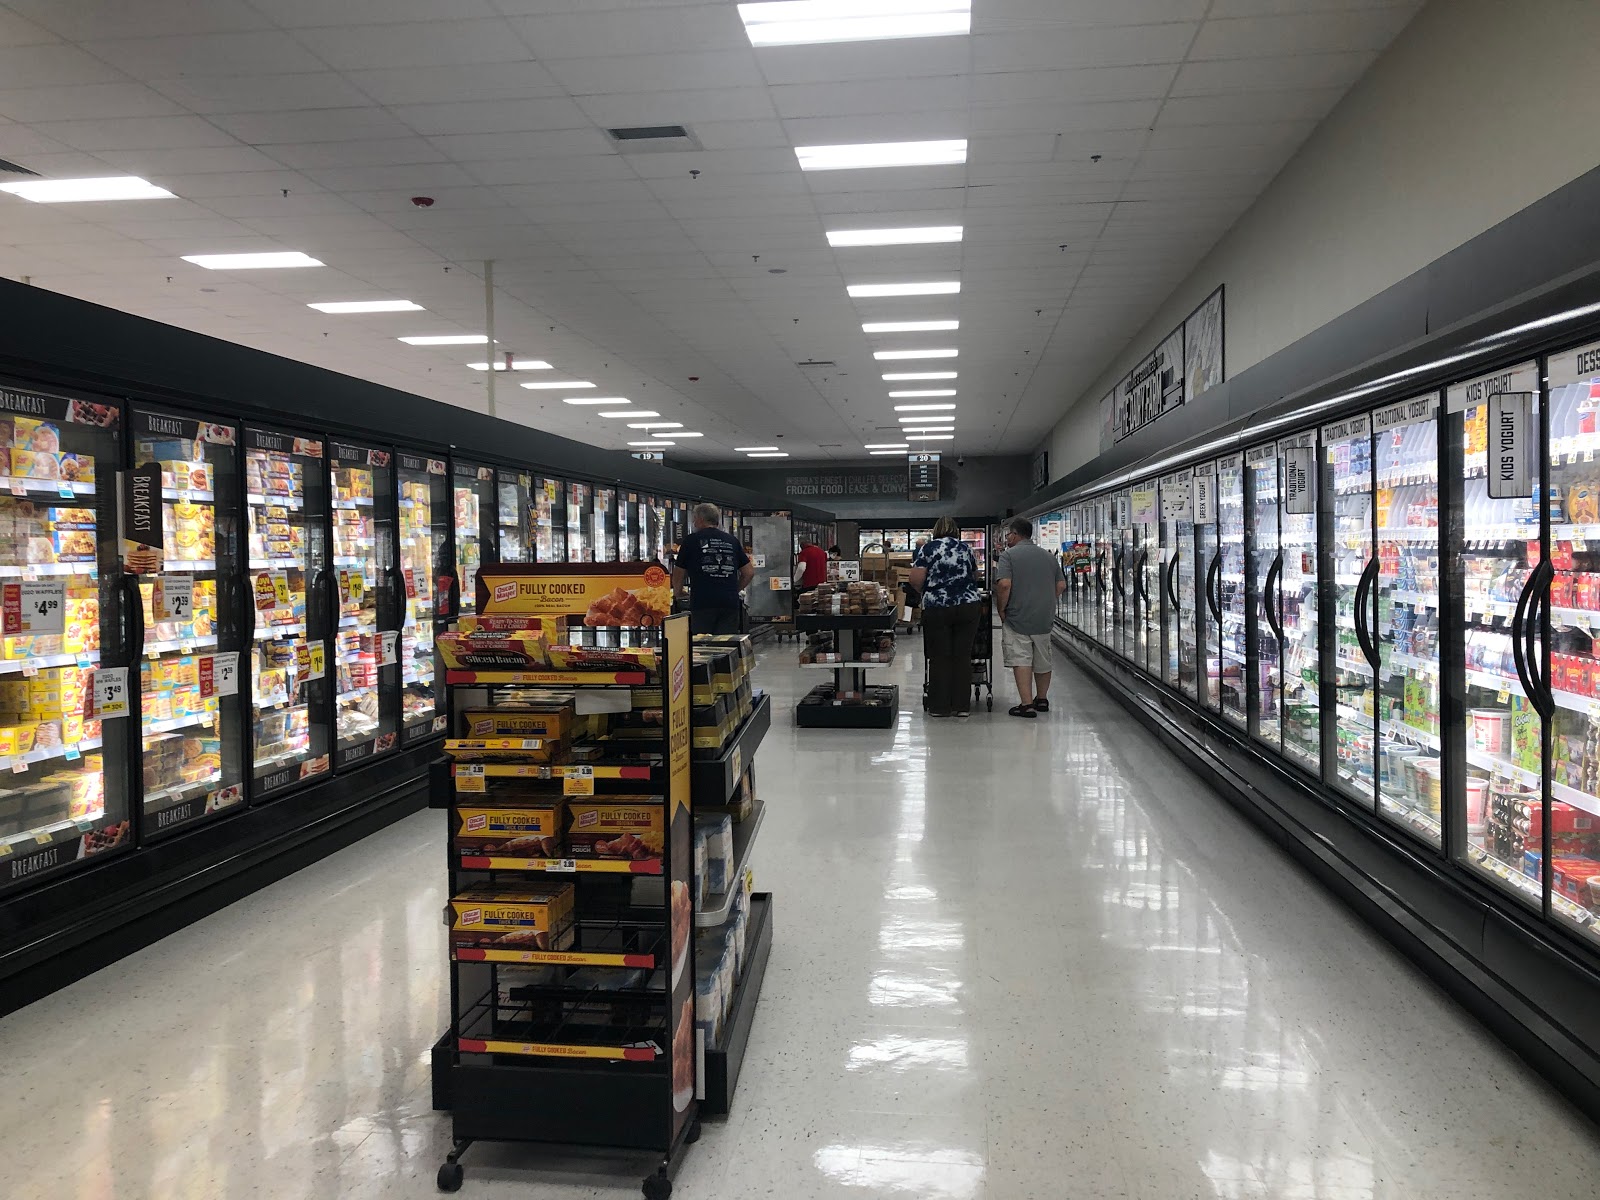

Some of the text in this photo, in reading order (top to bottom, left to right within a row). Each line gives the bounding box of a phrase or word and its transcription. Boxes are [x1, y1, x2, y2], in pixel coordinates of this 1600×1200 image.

[1466, 373, 1513, 403] KIDS YOGURT
[0, 391, 46, 415] BREAKFAST
[1375, 399, 1430, 428] TRADITIONAL YOGURT
[148, 415, 183, 436] BREAKFAST
[1349, 417, 1366, 436] YOGURT
[256, 434, 282, 450] BREAKFAST
[1501, 411, 1514, 481] KIDS YOGURT
[849, 484, 869, 493] EASE
[872, 484, 879, 493] &
[1289, 461, 1297, 501] TRADITIONAL
[1298, 469, 1306, 493] YOGURT
[786, 485, 843, 495] FROZEN FOOD
[133, 476, 151, 531] BREAKFAST
[496, 590, 517, 600] Mayer
[497, 584, 516, 594] Oscar
[520, 583, 586, 595] FULLY COOKED
[540, 595, 564, 603] Bacon
[496, 720, 547, 729] FULLY COOKED
[158, 803, 192, 828] BREAKFAST
[489, 816, 540, 825] FULLY COOKED
[600, 812, 651, 820] FULLY COOKED
[12, 848, 58, 879] BREAKFAST
[484, 910, 535, 919] FULLY COOKED
[547, 953, 567, 961] COOKED
